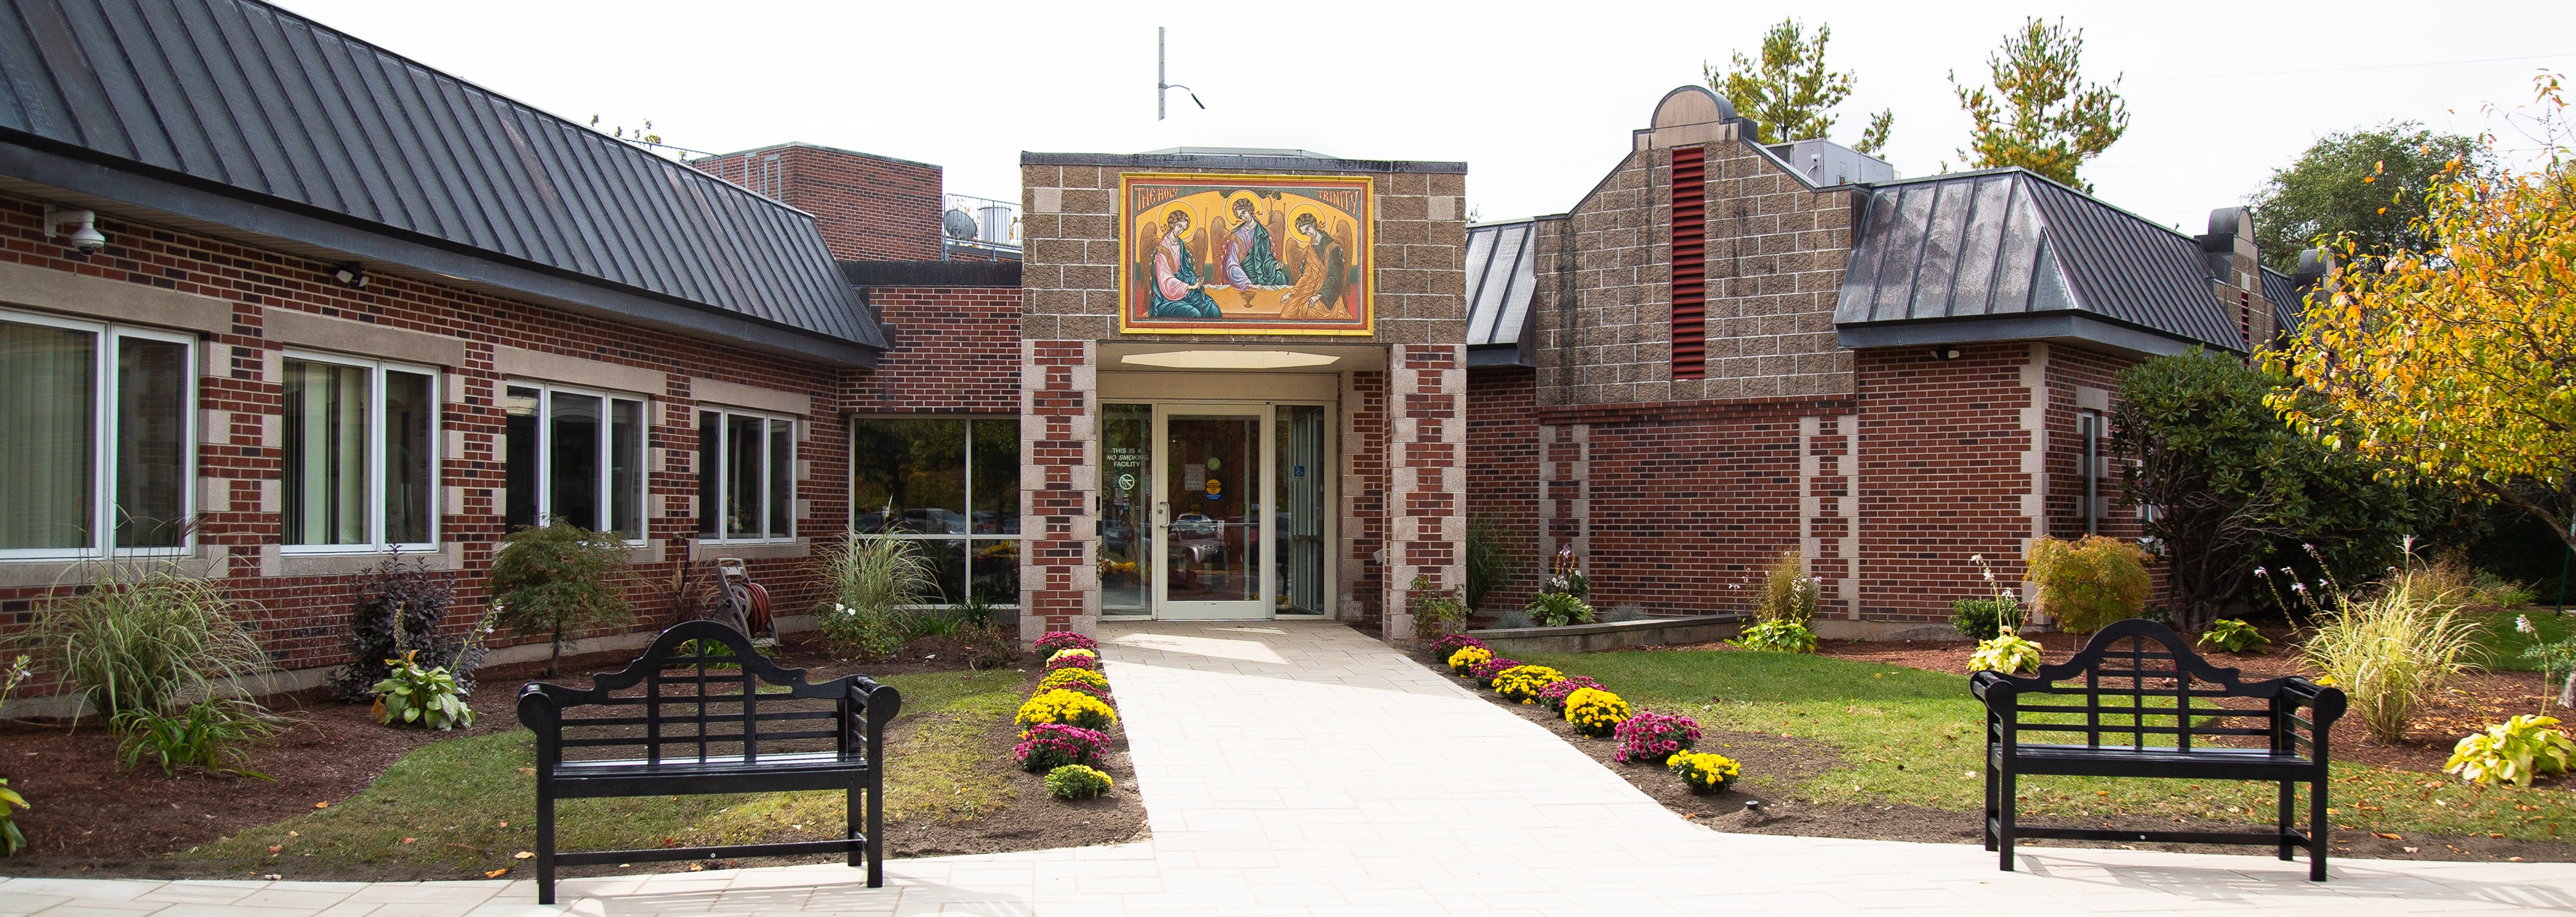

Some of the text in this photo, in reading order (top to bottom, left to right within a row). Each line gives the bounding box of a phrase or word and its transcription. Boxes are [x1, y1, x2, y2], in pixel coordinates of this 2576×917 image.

[1135, 188, 1359, 215] THE HOLY TRINITY
